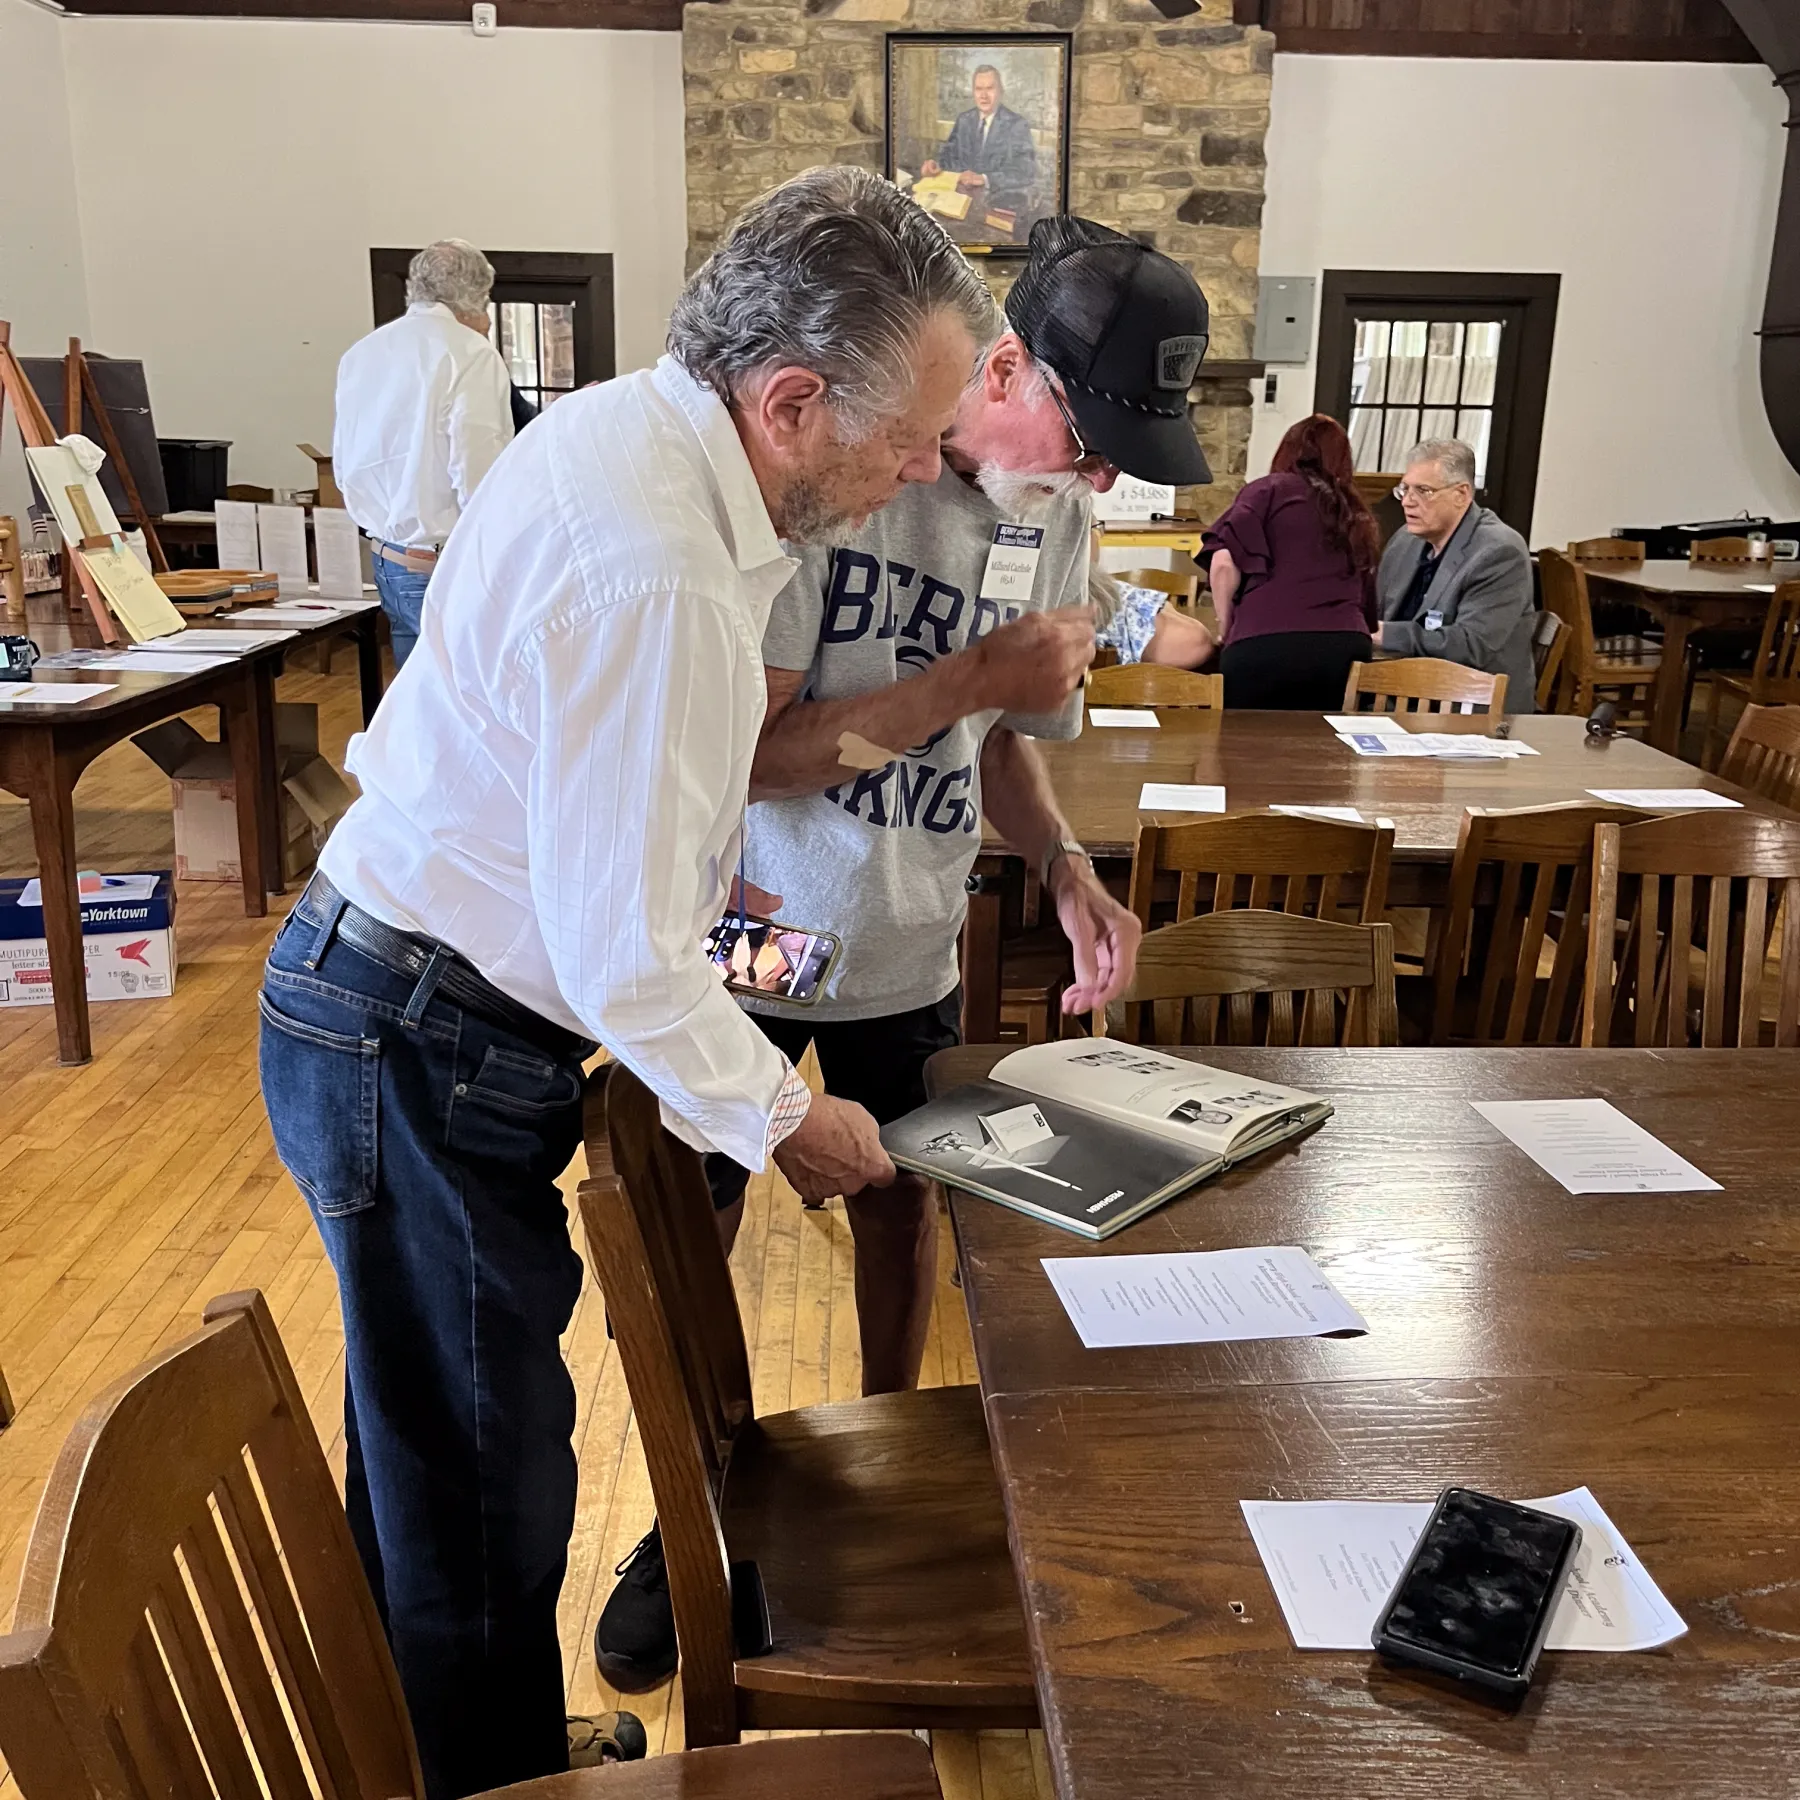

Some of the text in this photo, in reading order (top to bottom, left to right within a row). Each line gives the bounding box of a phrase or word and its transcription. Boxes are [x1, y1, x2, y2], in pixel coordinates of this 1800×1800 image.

[820, 548, 1020, 656] BERR
[89, 907, 148, 922] Yorktown
[0, 945, 101, 959] MULTIPUR PER
[12, 960, 51, 969] letter siz
[1086, 1190, 1124, 1214] FRESHMEN
[1566, 1589, 1592, 1618] Dinner
[1586, 1592, 1616, 1628] Academy
